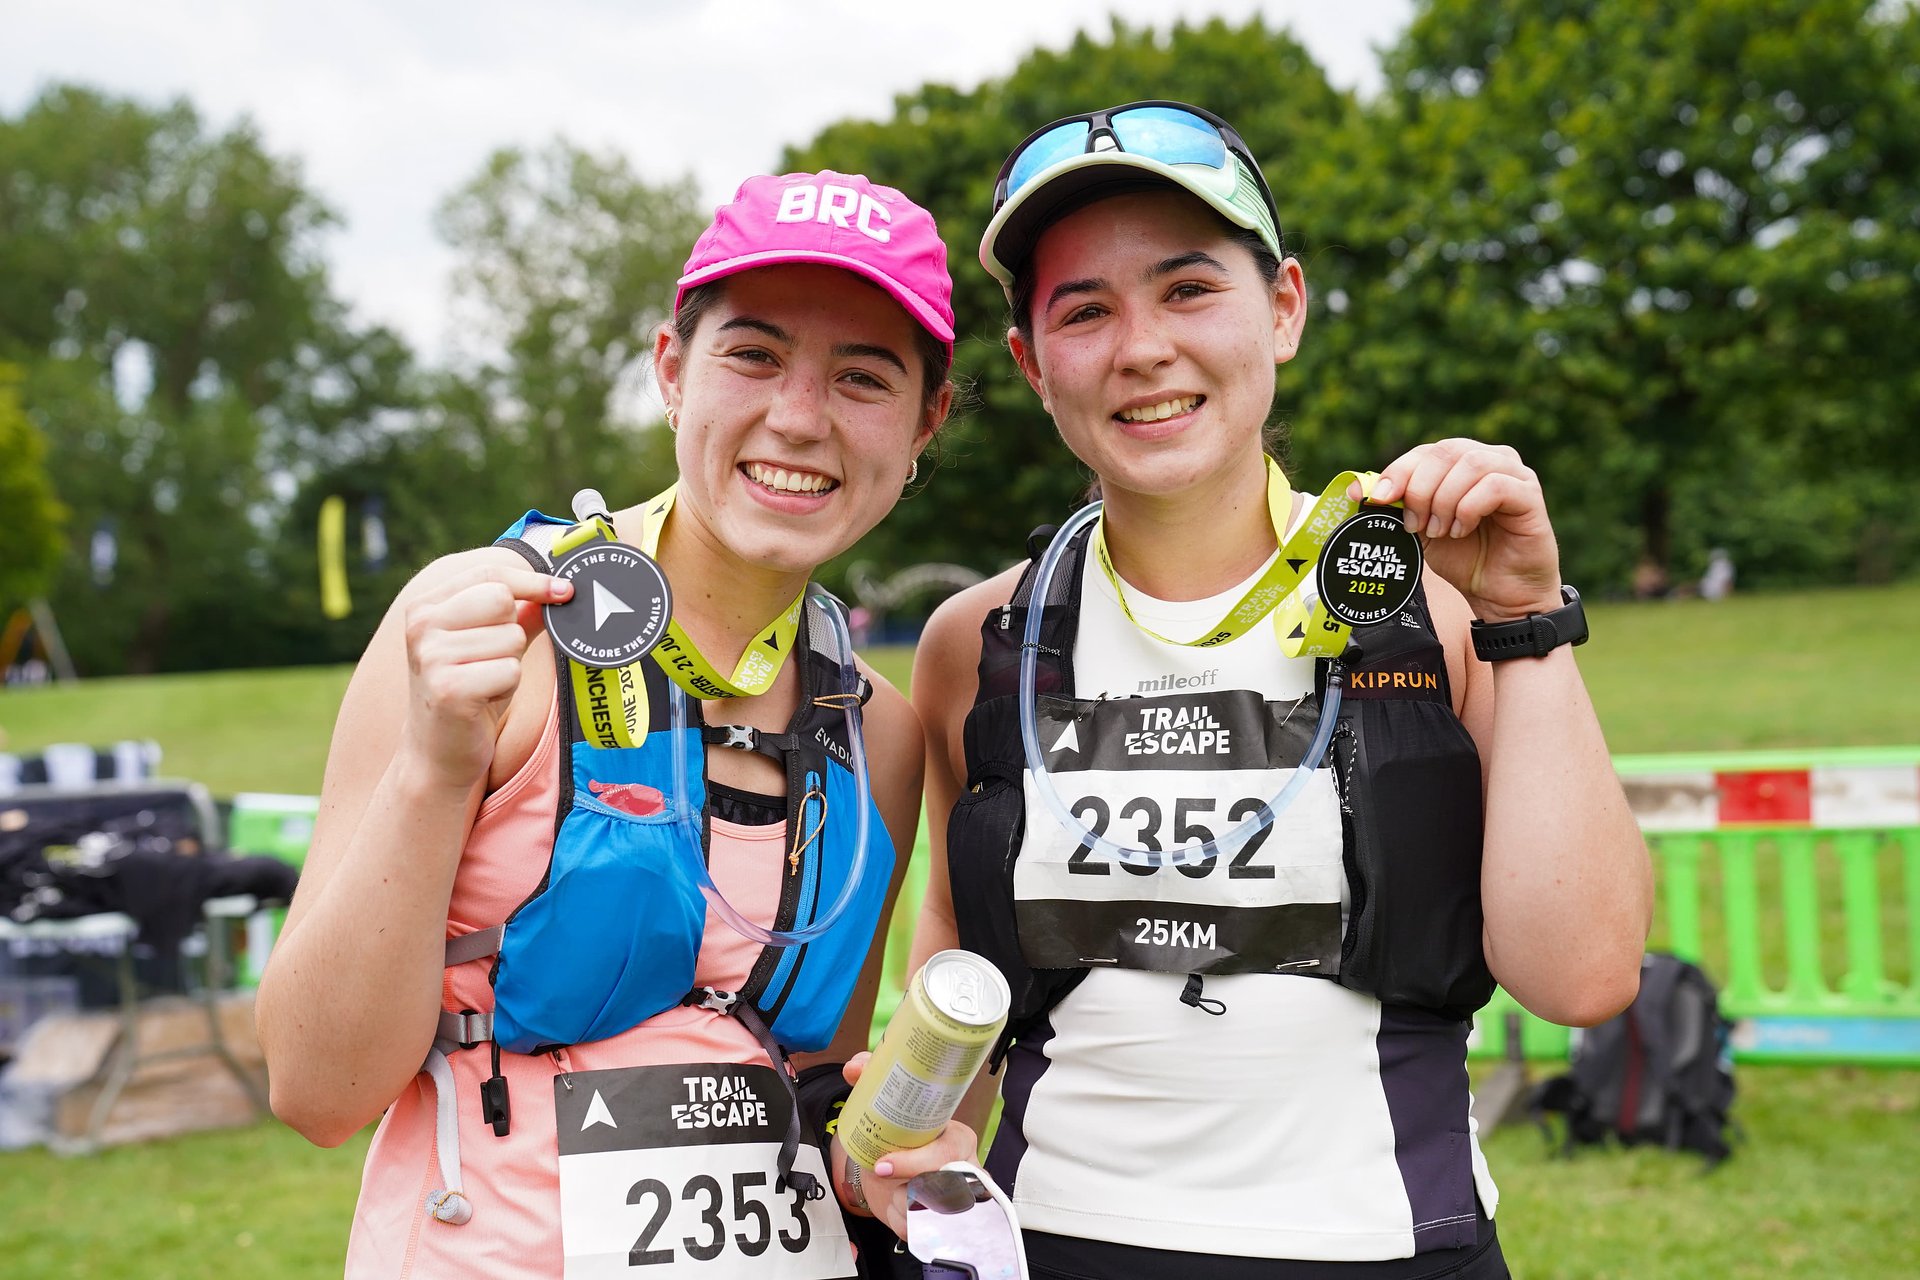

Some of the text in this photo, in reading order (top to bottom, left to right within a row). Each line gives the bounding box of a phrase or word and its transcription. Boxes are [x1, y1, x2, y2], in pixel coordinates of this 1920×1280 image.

[776, 184, 892, 243] BRC
[1367, 519, 1396, 531] 25KM
[582, 553, 605, 567] THE
[610, 553, 638, 568] CITY
[1349, 541, 1401, 564] TRAIL
[1336, 557, 1407, 581] ESCAPE
[1348, 580, 1386, 596] 2025
[1337, 602, 1388, 620] FINISHER
[571, 596, 661, 658] EXPLORE THE TRAILS
[672, 655, 694, 671] 21
[1137, 668, 1219, 693] mileoff
[1351, 671, 1438, 690] KIPRUN
[1139, 705, 1220, 732] TRAIL
[1124, 729, 1230, 755] ESCAPE
[1067, 795, 1276, 880] 2352
[1134, 917, 1217, 951] 25KM
[682, 1076, 757, 1103] TRAIL
[671, 1101, 768, 1130] ESCAPE
[625, 1171, 811, 1267] 2353
